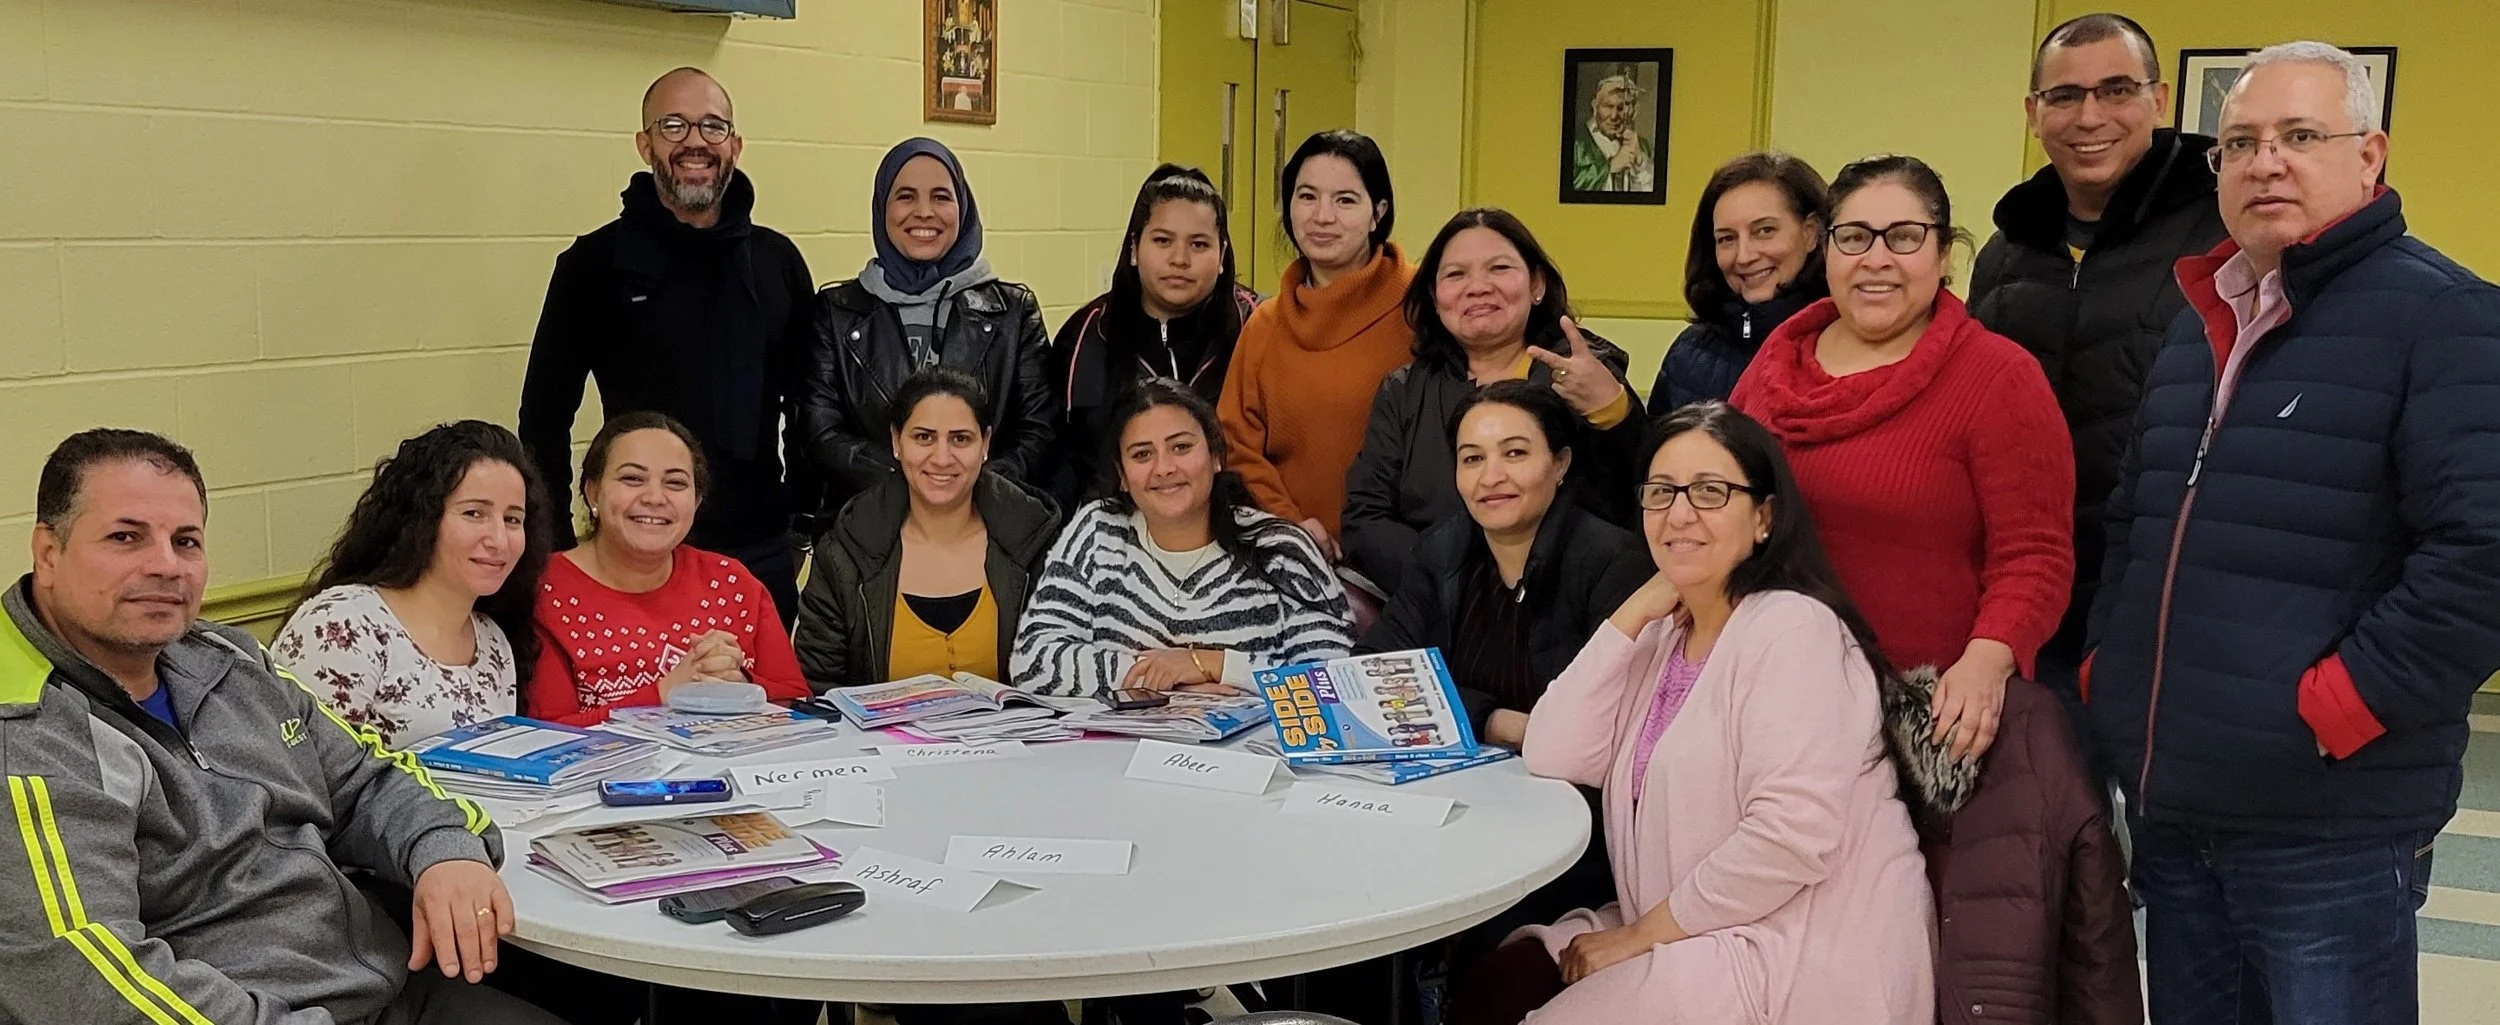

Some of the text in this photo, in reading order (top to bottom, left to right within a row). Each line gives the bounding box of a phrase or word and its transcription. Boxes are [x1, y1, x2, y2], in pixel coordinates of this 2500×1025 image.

[1314, 670, 1337, 700] Plus
[1265, 684, 1307, 747] SIDE
[1285, 673, 1327, 735] SIDE
[754, 765, 868, 786] Nermen
[1163, 753, 1220, 773] Abeer
[982, 844, 1062, 863] Ahlam
[856, 864, 944, 895] Ashraf
